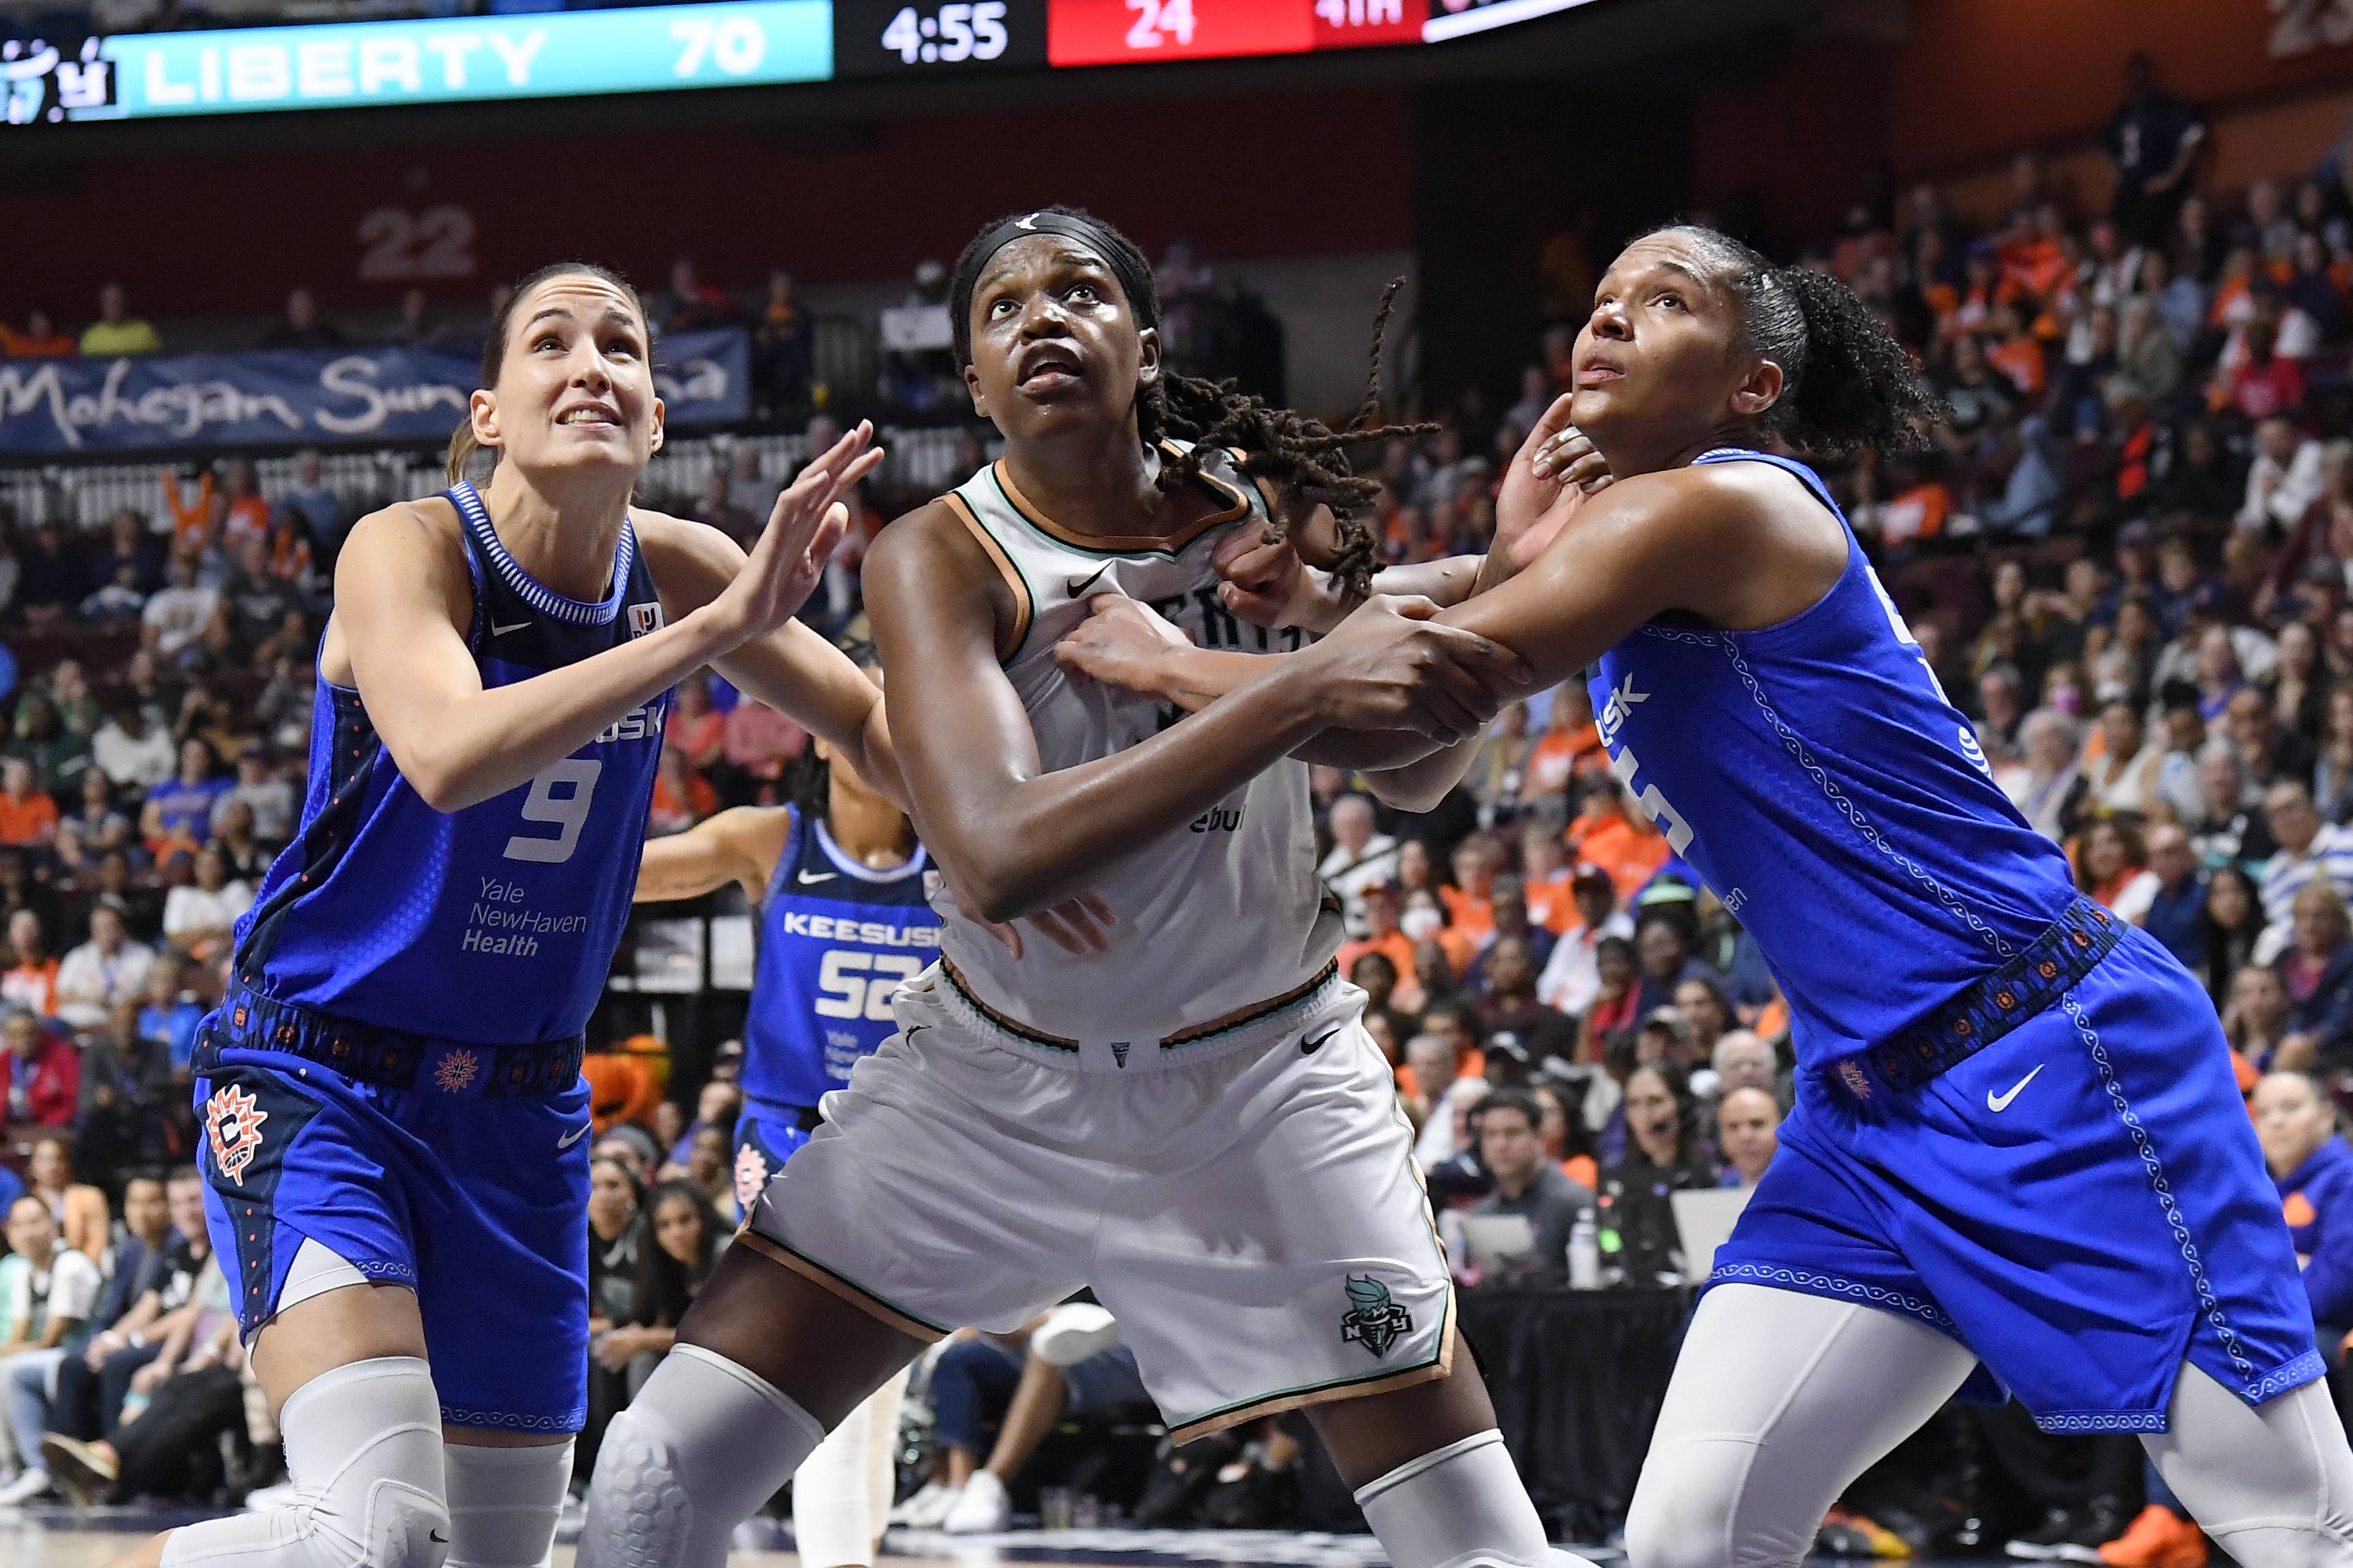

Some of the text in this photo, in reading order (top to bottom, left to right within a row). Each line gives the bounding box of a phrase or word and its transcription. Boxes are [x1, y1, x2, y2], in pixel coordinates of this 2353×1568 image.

[145, 31, 548, 105] LIBERTY
[670, 18, 765, 78] 70
[882, 1, 1008, 65] 4:55
[1125, 0, 1194, 48] 24
[358, 206, 477, 281] 22
[315, 356, 467, 434] Sun
[503, 758, 602, 863] 9
[469, 902, 587, 932] NewHaven
[481, 876, 525, 903] Yale
[461, 928, 538, 956] Health
[815, 950, 923, 1022] 52
